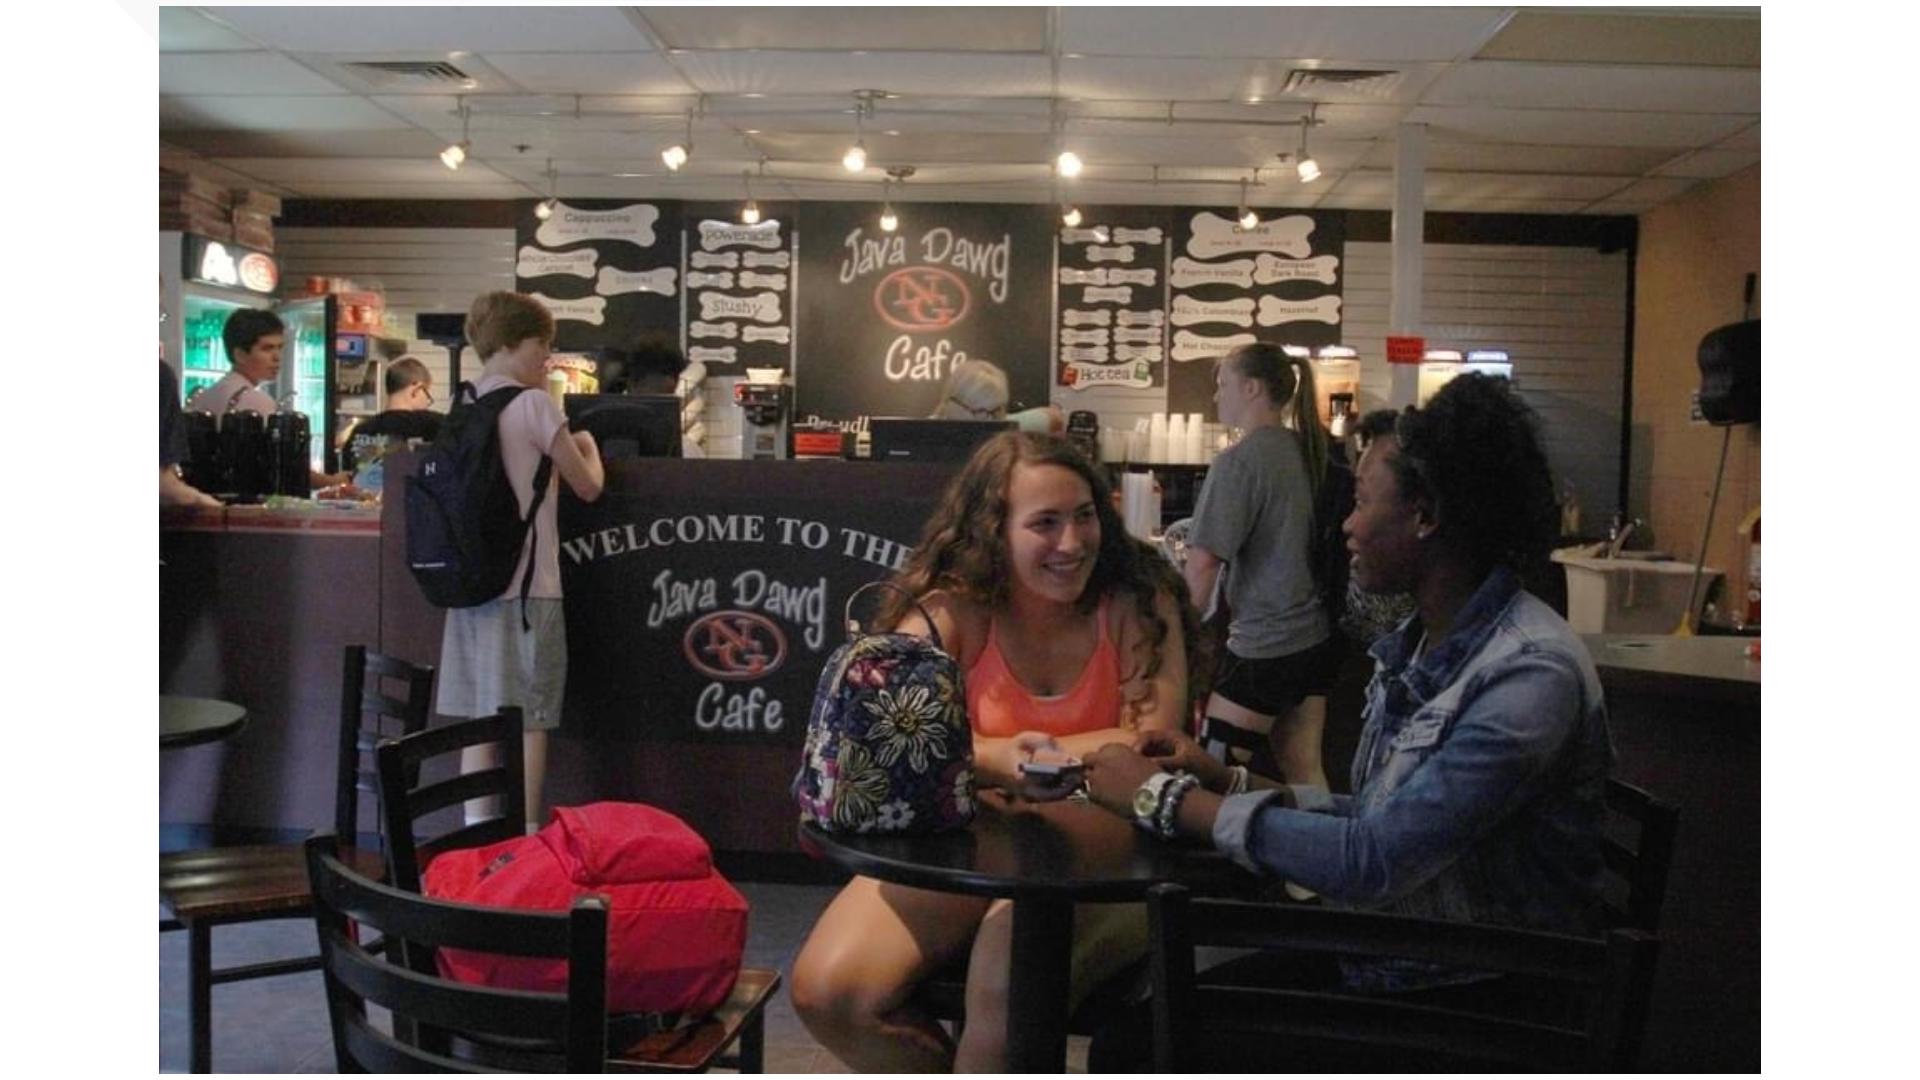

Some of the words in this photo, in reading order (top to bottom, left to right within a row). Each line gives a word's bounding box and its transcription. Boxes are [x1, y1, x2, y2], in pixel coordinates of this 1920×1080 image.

[564, 212, 632, 223] Cappuccino
[839, 227, 906, 284] Java
[920, 227, 1011, 304] Dawg
[1080, 367, 1104, 380] Hot
[1107, 367, 1130, 380] tea
[561, 515, 764, 565] WELCOME
[776, 517, 829, 550] TO
[647, 569, 717, 627] Java
[732, 569, 827, 648] Dawg
[695, 682, 784, 731] Cafe
